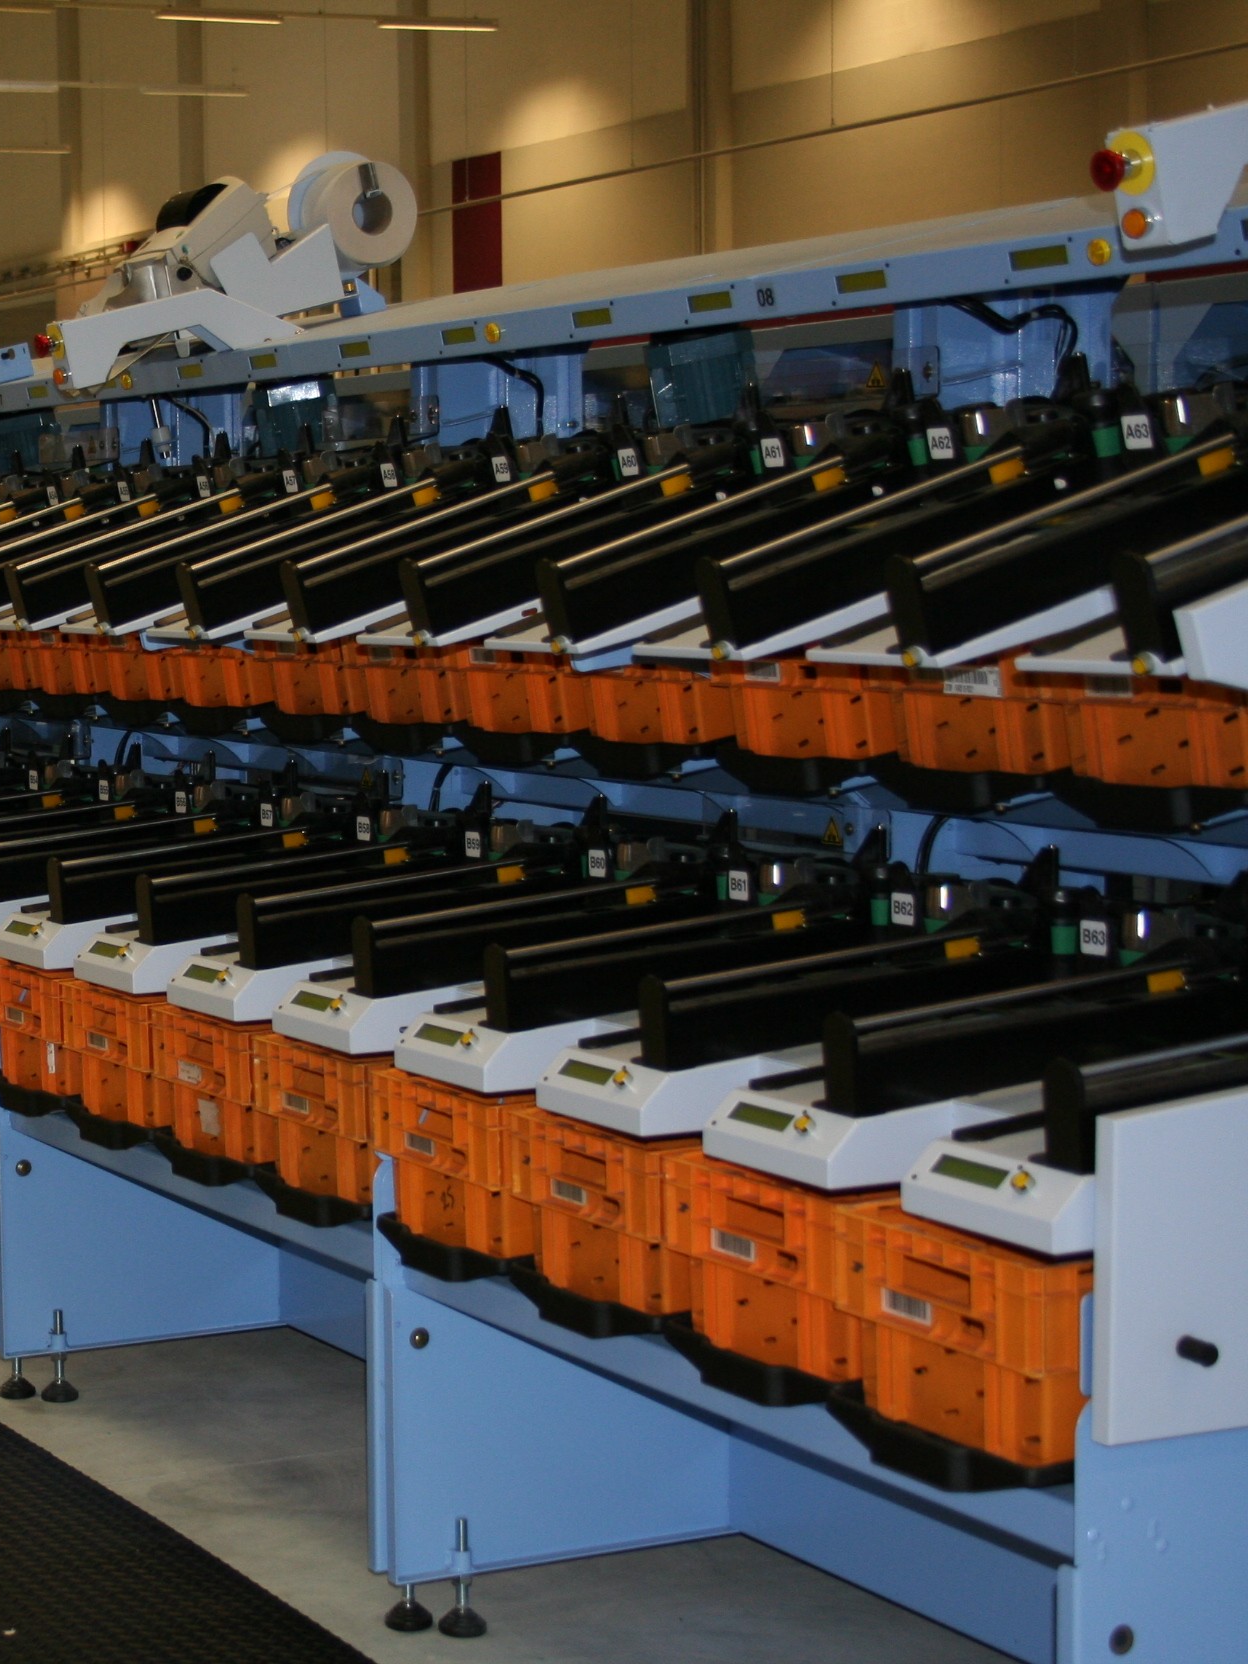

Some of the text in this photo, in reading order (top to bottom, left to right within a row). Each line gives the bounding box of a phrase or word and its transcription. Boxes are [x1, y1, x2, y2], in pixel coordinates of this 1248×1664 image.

[757, 288, 774, 306] 08
[1126, 424, 1149, 440] A63
[931, 436, 952, 450] A62
[764, 446, 782, 459] A61
[495, 462, 509, 474] A59
[622, 455, 637, 468] A60
[286, 475, 296, 486] A57
[383, 468, 395, 480] A58
[467, 838, 481, 850] B59
[590, 856, 606, 869] B60
[730, 878, 747, 891] B61
[893, 901, 914, 916] B62
[1083, 928, 1106, 945] B63
